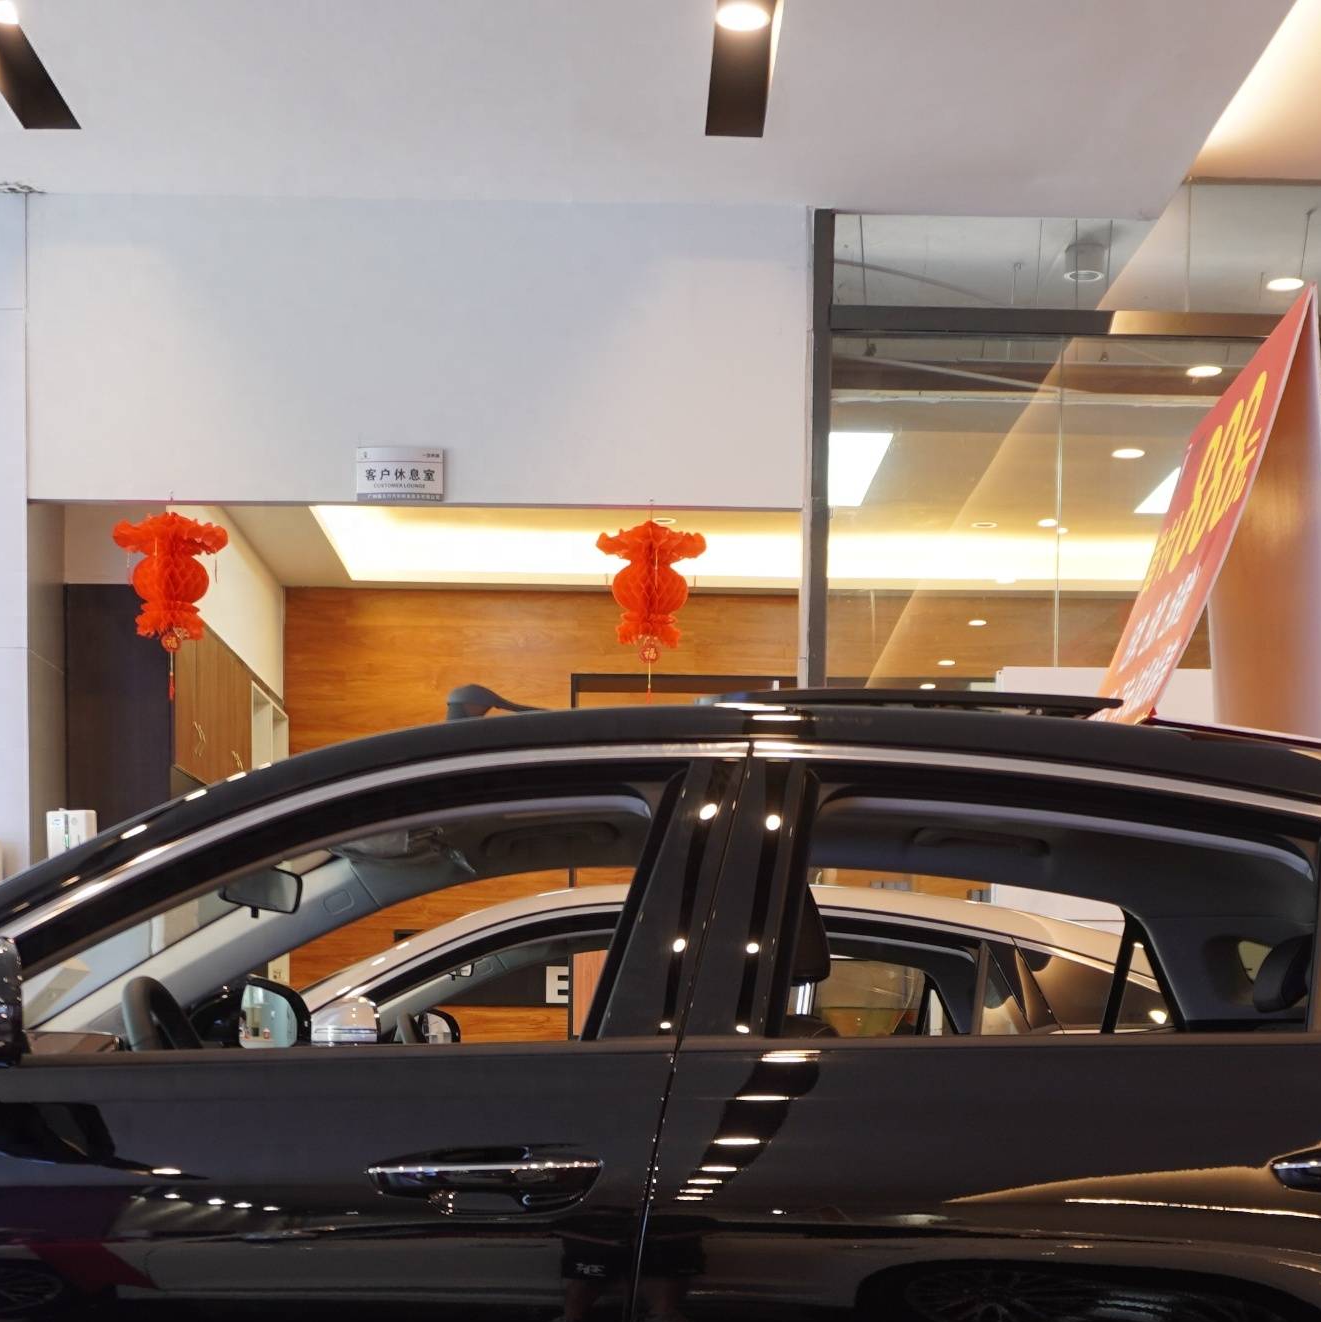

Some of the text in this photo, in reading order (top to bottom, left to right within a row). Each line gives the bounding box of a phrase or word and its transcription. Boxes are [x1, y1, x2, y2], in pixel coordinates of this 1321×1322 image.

[365, 467, 436, 482] 客户休息室
